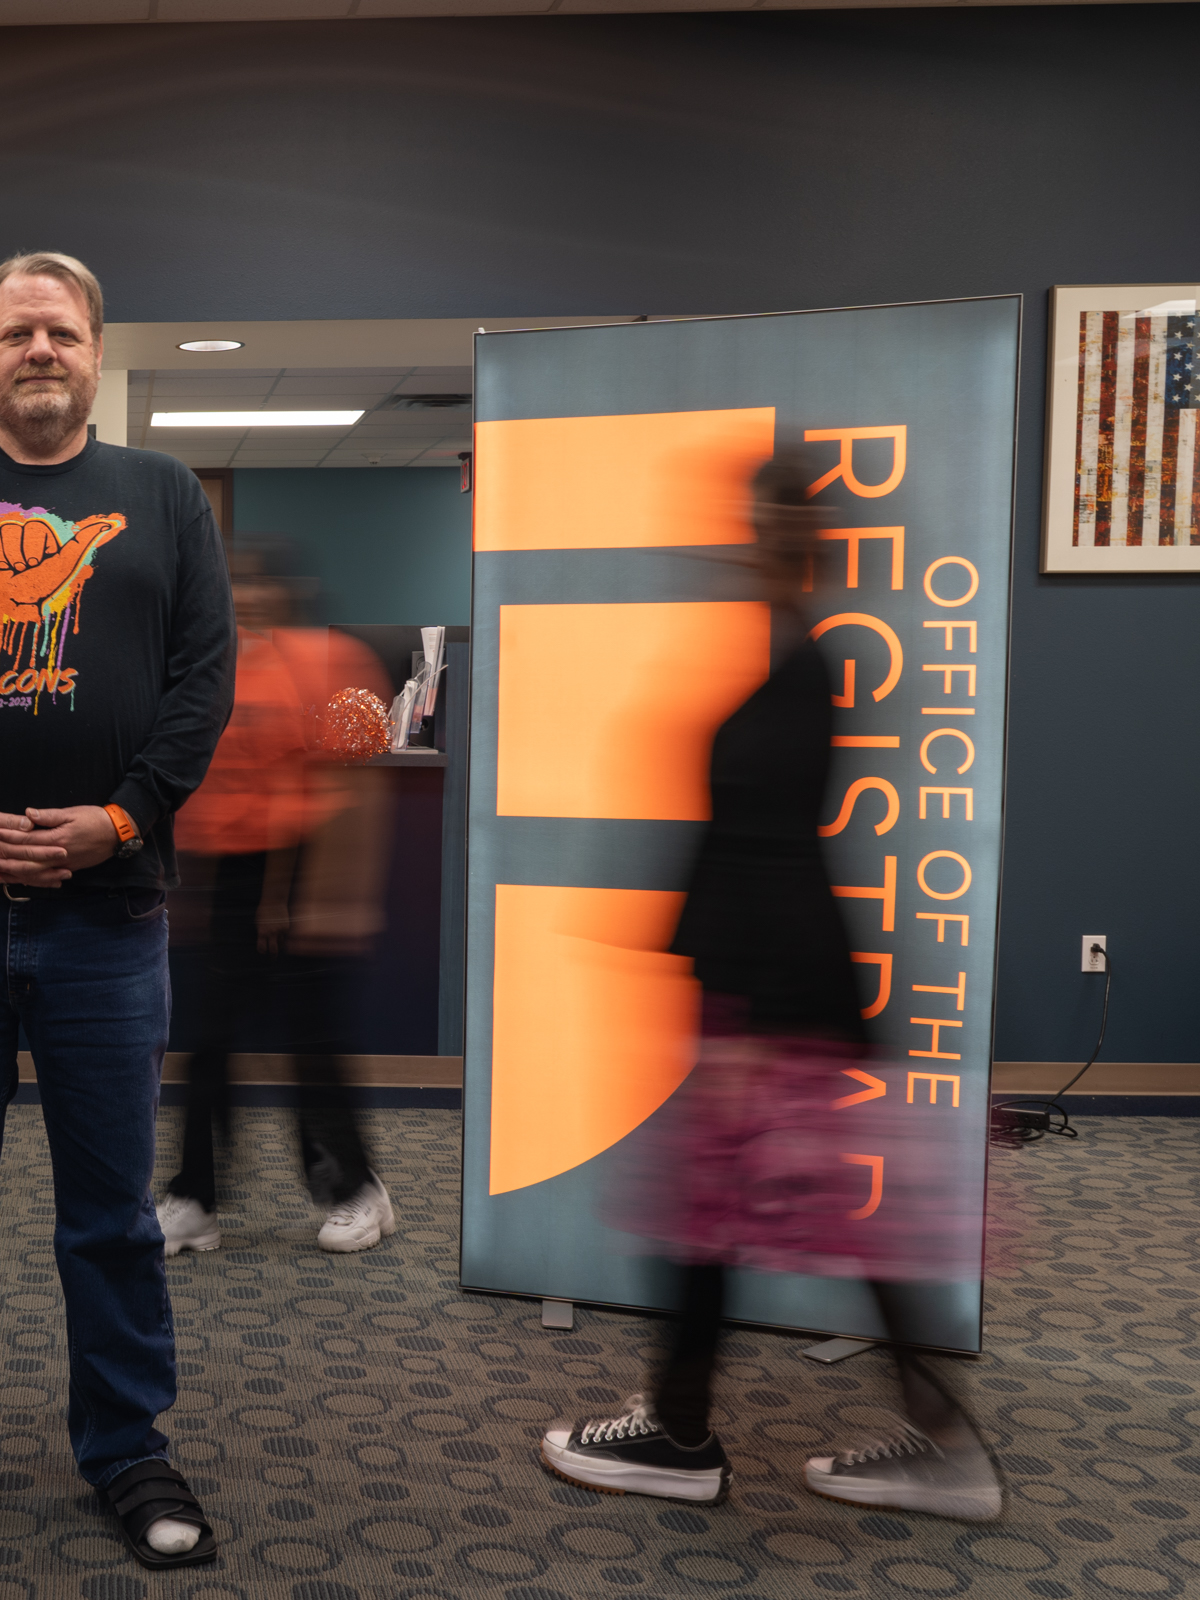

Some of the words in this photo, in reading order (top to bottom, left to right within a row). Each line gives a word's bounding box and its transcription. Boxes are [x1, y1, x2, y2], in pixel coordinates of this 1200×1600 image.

[919, 555, 979, 821] OFFICE
[916, 849, 973, 947] OF
[906, 971, 966, 1108] THE
